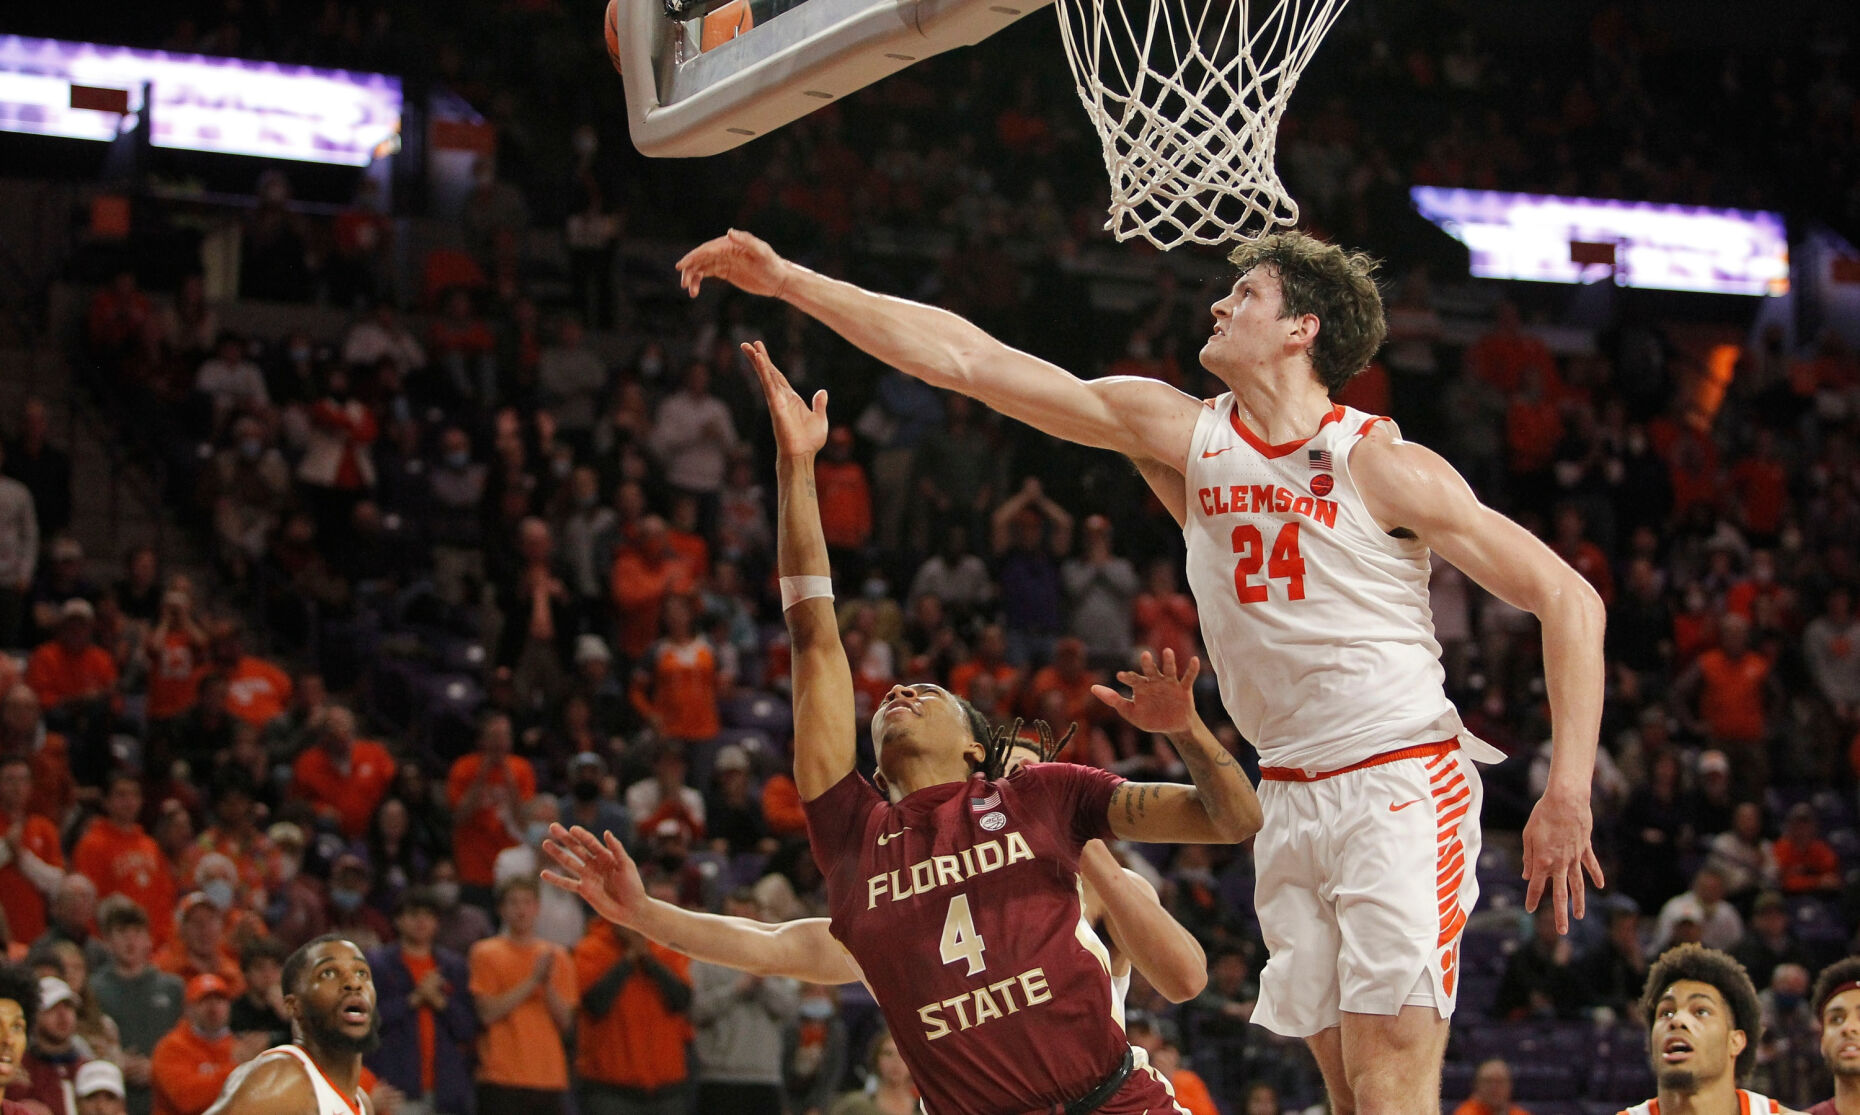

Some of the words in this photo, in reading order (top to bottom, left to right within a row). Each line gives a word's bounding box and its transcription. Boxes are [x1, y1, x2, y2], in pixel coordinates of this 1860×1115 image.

[1198, 484, 1338, 529] CLEMSON
[1231, 522, 1306, 604] 24
[867, 832, 1036, 910] FLORIDA
[939, 893, 986, 977] 4
[917, 967, 1053, 1041] STATE
